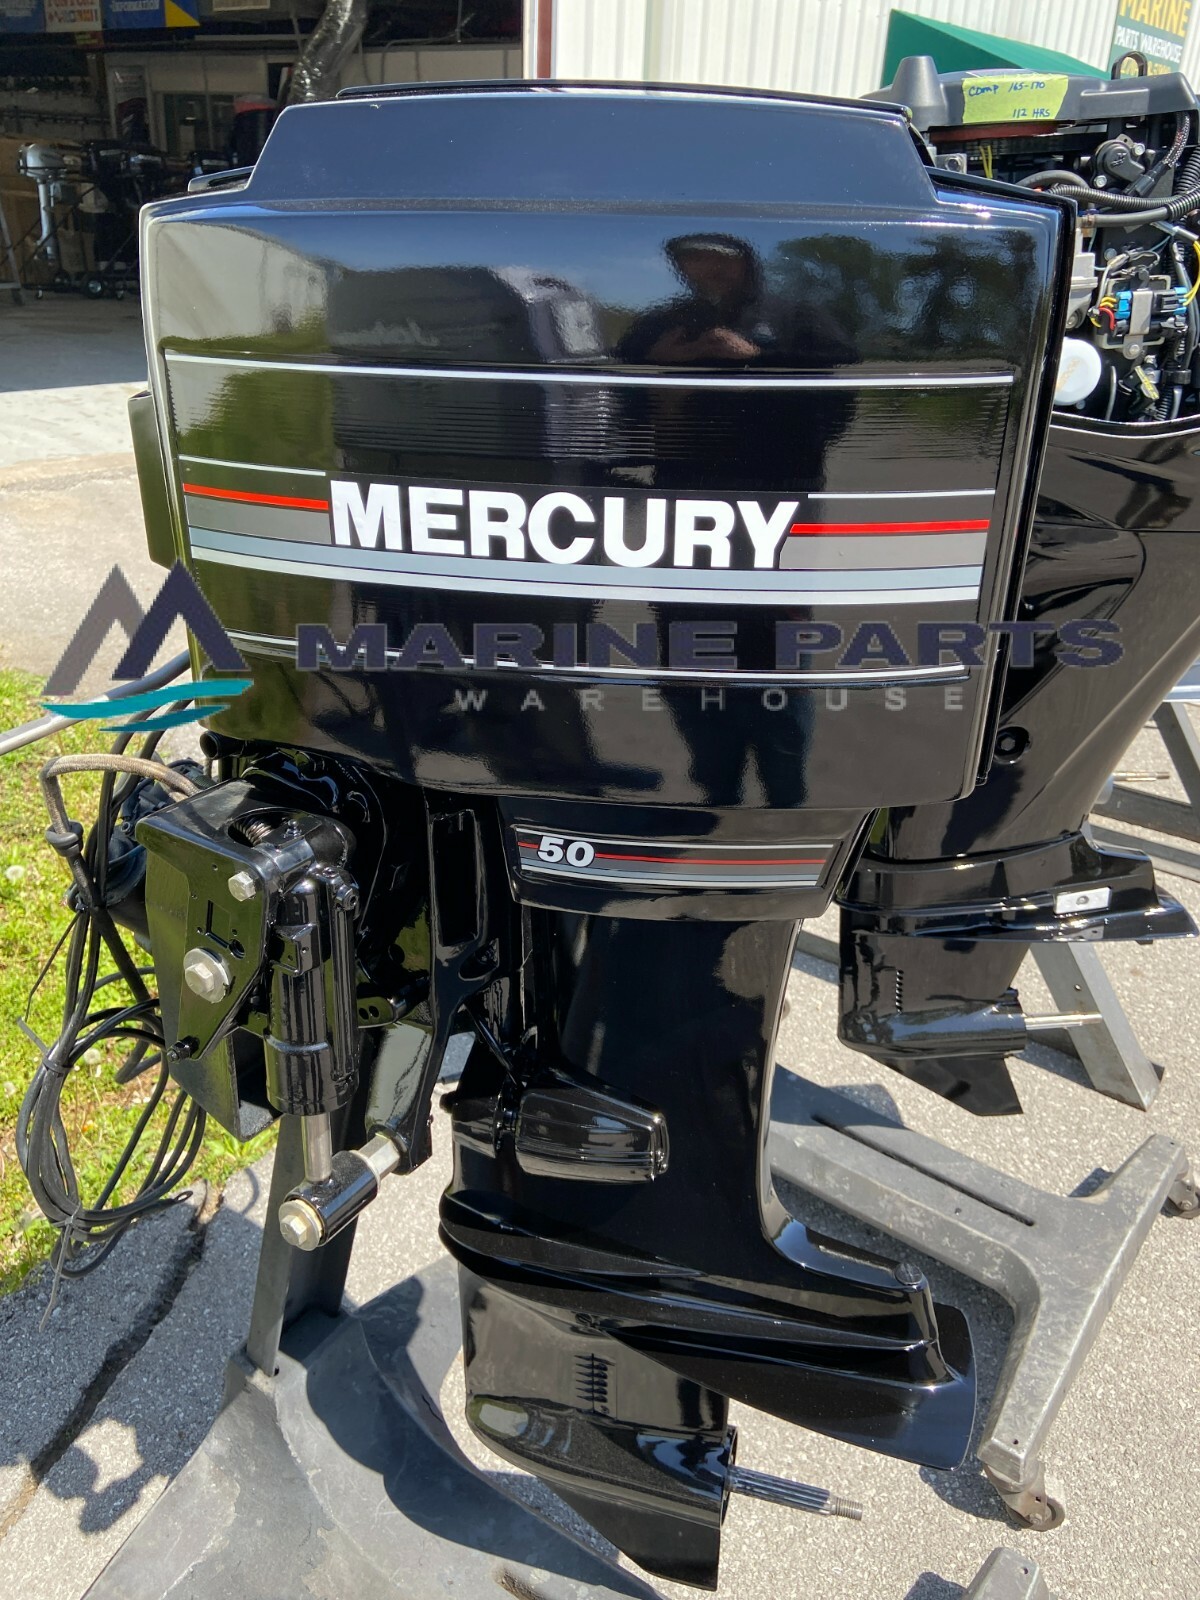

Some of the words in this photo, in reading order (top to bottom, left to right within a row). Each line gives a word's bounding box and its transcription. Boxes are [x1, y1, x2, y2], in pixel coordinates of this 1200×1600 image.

[1119, 0, 1190, 37] MARINE
[1114, 25, 1140, 50] PARTS
[1140, 32, 1183, 64] WAREHOUSE
[1008, 81, 1046, 93] 165-170
[1013, 109, 1027, 119] 112
[1032, 109, 1050, 117] HRS
[330, 480, 799, 568] MERCURY
[537, 835, 595, 868] 50
